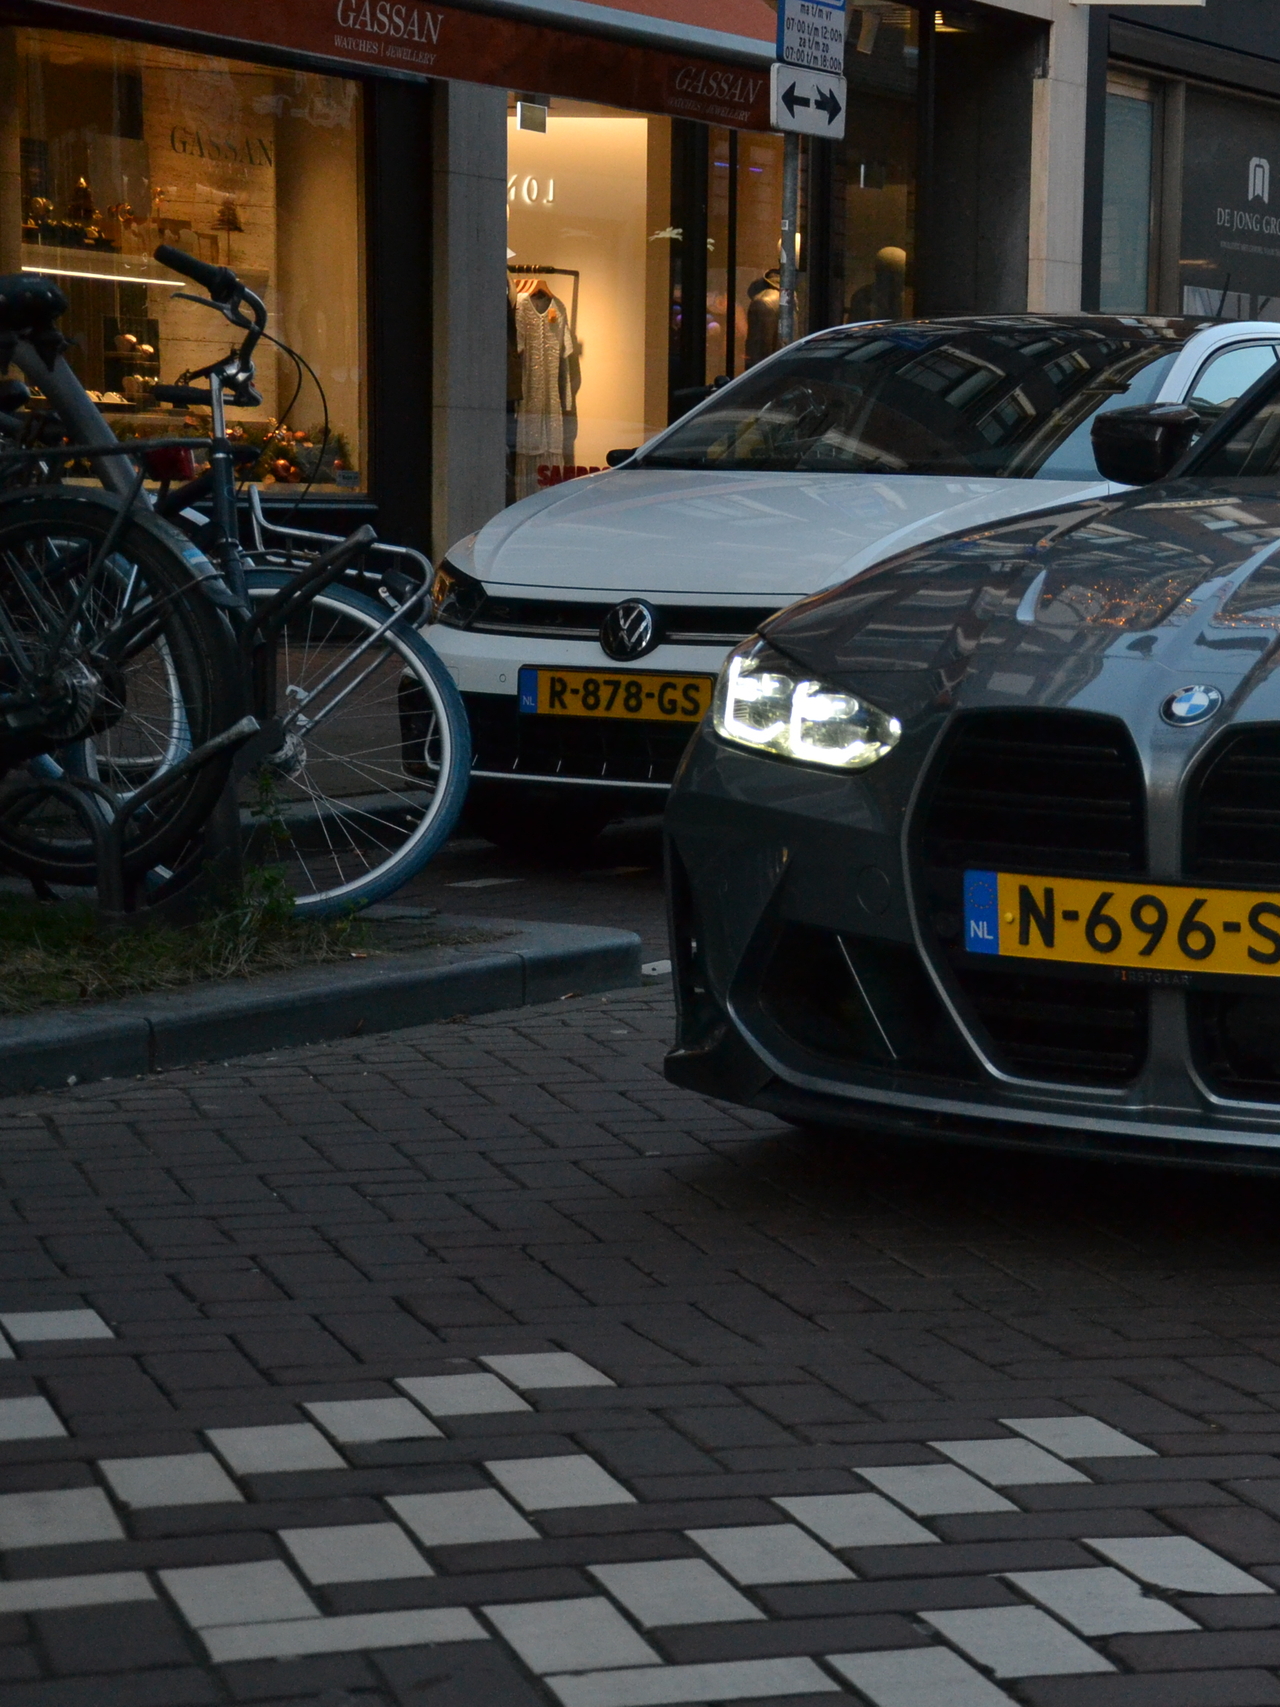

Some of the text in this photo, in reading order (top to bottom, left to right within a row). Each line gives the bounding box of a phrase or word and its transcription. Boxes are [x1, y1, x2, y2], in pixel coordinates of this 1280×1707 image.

[800, 4, 809, 16] ma
[811, 4, 823, 19] t/m
[337, 0, 444, 45] GASSAN
[807, 22, 819, 37] t/m
[334, 34, 437, 65] WATCHES JEWELLERY
[808, 37, 820, 51] t/m
[806, 51, 818, 66] t/m
[675, 66, 763, 104] GASSAN
[706, 104, 751, 122] JEWELLERY
[170, 125, 274, 168] GASSAN
[1217, 207, 1231, 227] DE
[1233, 210, 1260, 232] JONG
[522, 695, 535, 707] NL
[549, 676, 701, 716] R-878-GS
[969, 920, 993, 940] NL
